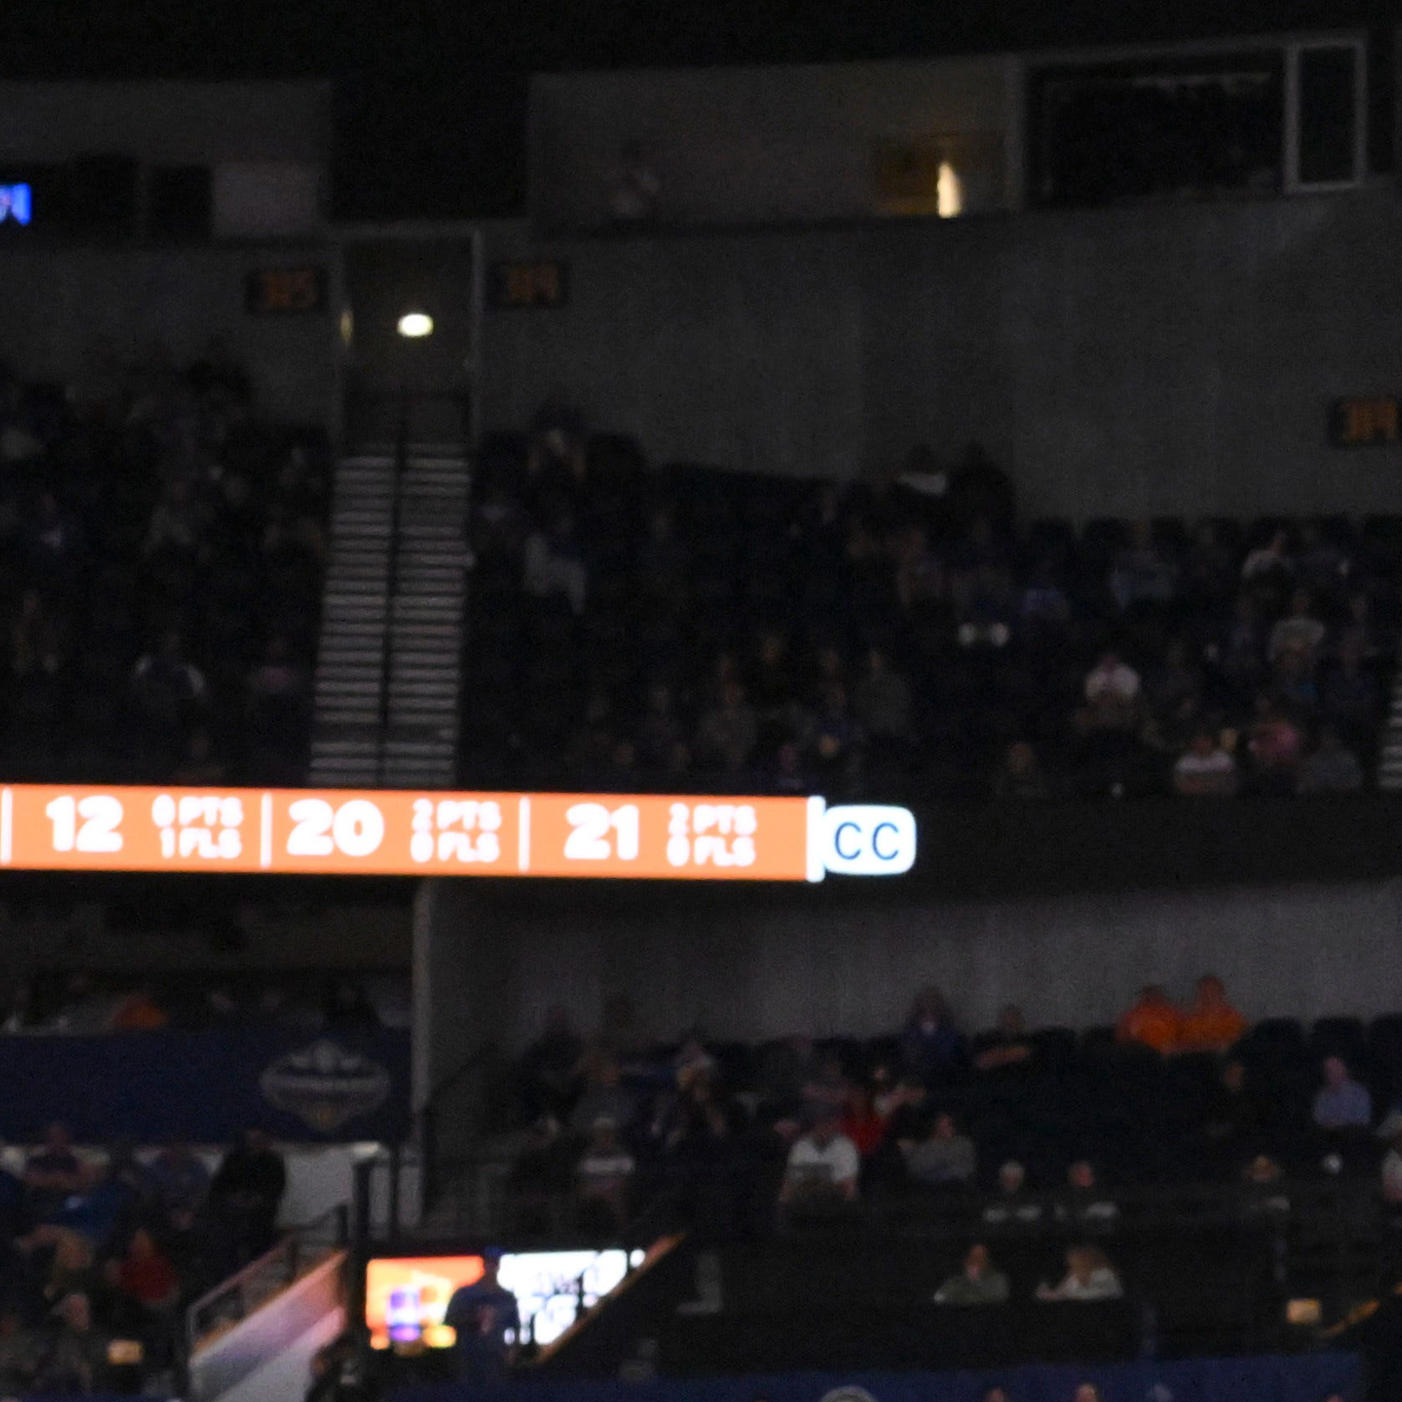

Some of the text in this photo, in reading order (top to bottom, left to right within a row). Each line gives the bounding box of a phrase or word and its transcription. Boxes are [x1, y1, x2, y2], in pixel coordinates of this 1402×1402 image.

[46, 795, 124, 852] 12
[287, 799, 384, 857] 20
[564, 803, 639, 860] 21
